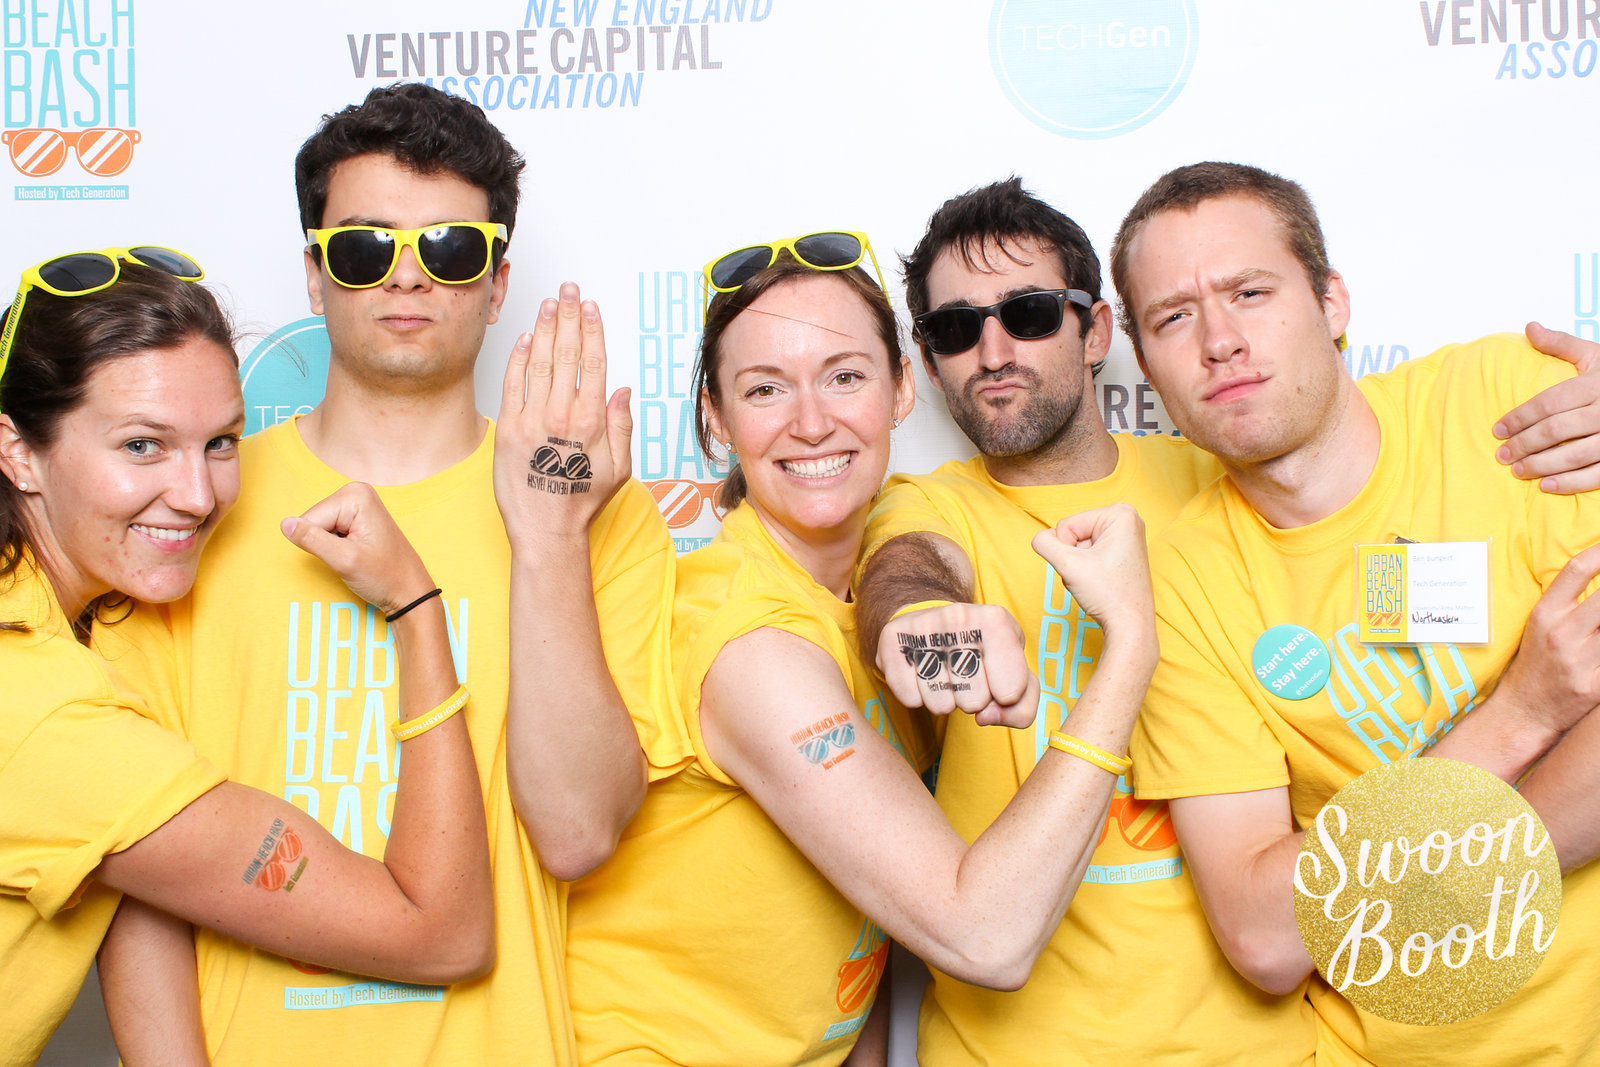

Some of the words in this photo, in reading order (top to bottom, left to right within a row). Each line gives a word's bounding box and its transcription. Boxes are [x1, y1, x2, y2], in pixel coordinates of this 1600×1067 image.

[3, 0, 135, 48] BEACH
[524, 0, 599, 28] NEW
[611, 0, 773, 26] ENGLAND
[347, 30, 538, 78] VENTURE
[550, 25, 723, 74] CAPITAL
[4, 48, 136, 128] BASH
[18, 187, 46, 199] Hosted
[48, 187, 58, 200] by
[61, 187, 80, 199] Tech
[82, 186, 126, 199] Generation
[1366, 554, 1403, 571] URBAN
[1366, 571, 1403, 590] BEACH
[1366, 590, 1403, 612] BASH
[287, 598, 468, 689] URBN
[929, 632, 958, 648] BEACH
[1256, 653, 1285, 679] Start
[1278, 632, 1310, 657] here.
[1271, 668, 1297, 692] Stay
[1291, 647, 1323, 672] here.
[1089, 868, 1100, 883] by
[1103, 867, 1127, 881] Tech
[1130, 860, 1180, 880] Generation
[289, 989, 328, 1007] Hosted
[332, 989, 346, 1008] by
[348, 985, 375, 1002] Tech
[378, 983, 438, 1000] Generation
